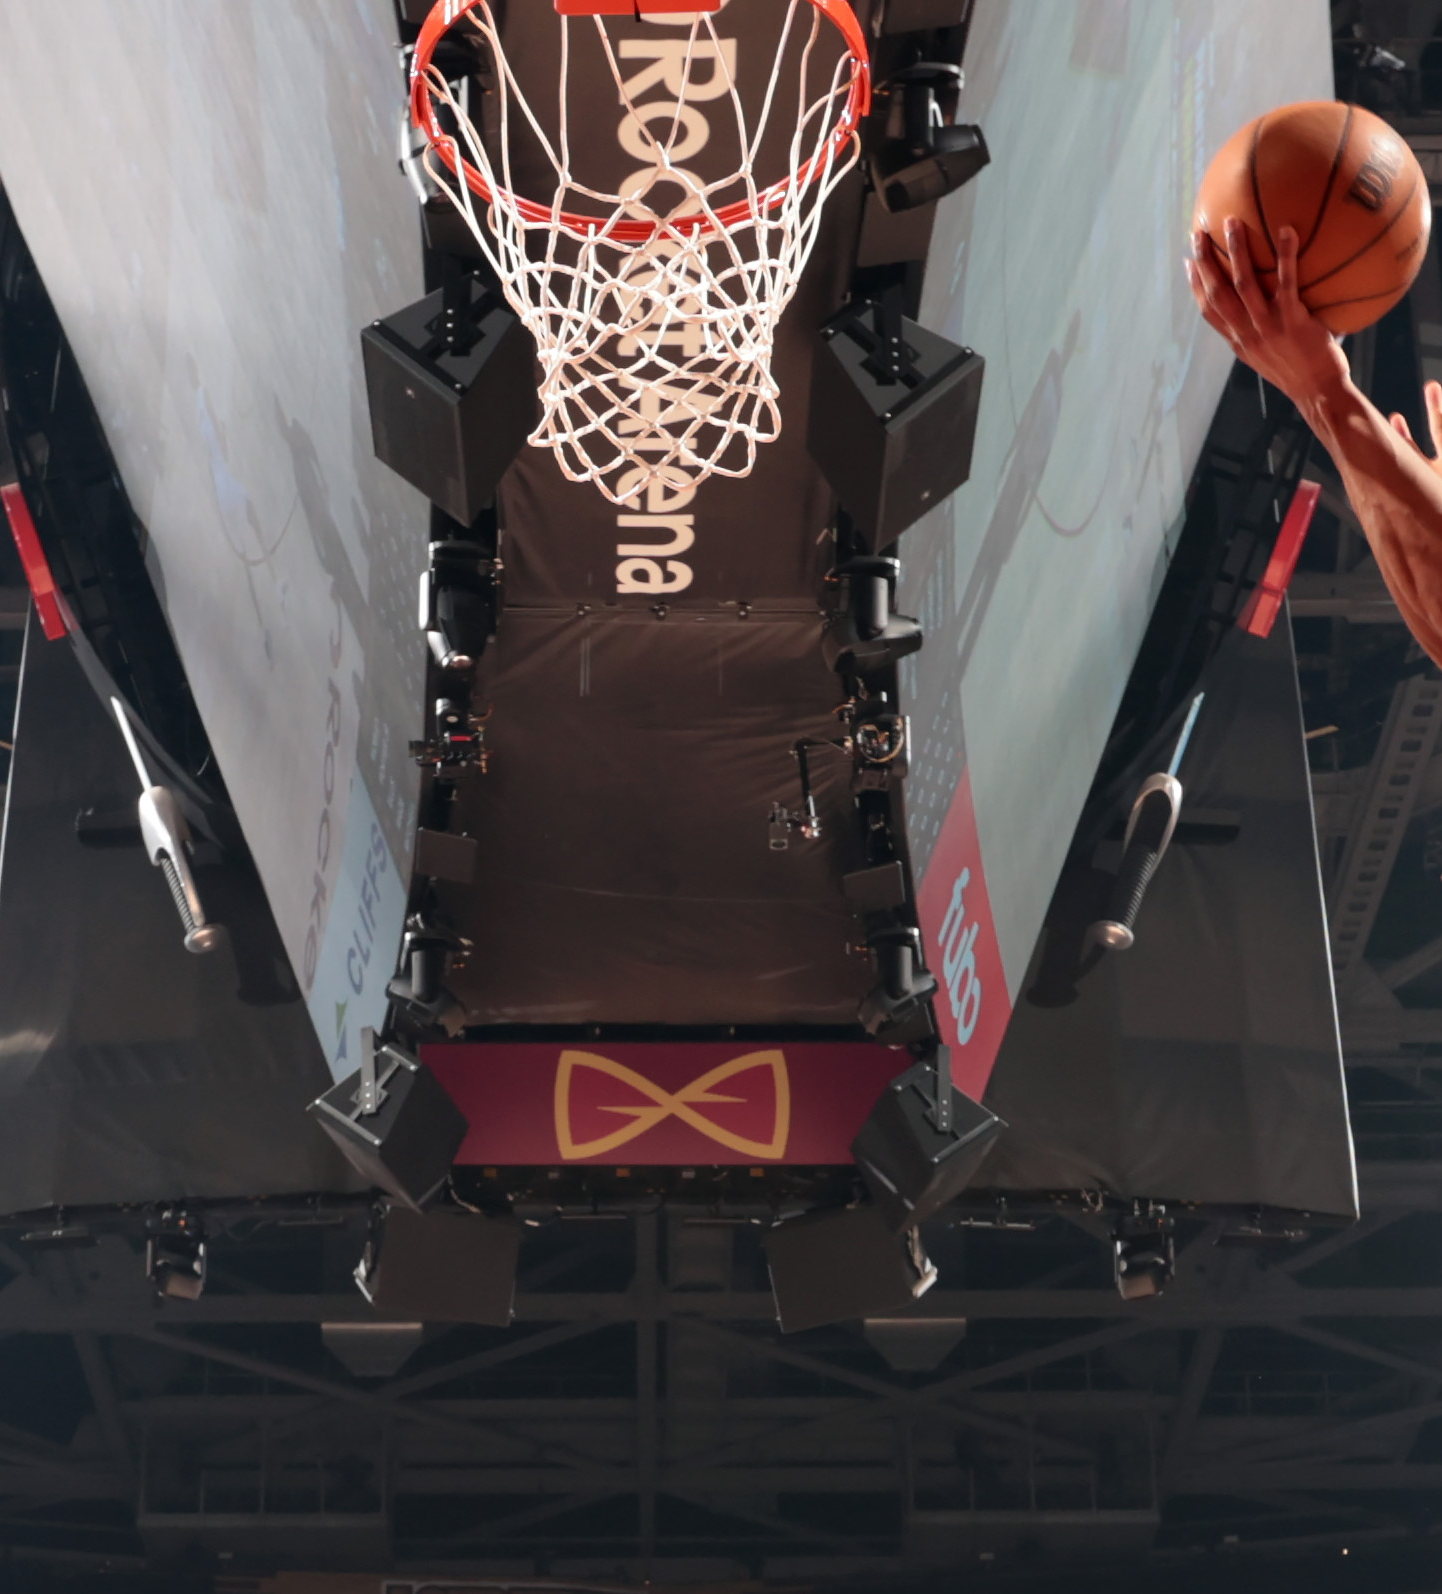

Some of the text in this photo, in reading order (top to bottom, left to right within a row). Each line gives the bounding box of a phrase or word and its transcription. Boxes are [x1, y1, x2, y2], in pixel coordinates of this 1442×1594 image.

[615, 366, 725, 595] Arena
[345, 820, 391, 996] CLIFFS
[938, 866, 981, 1046] fubo
